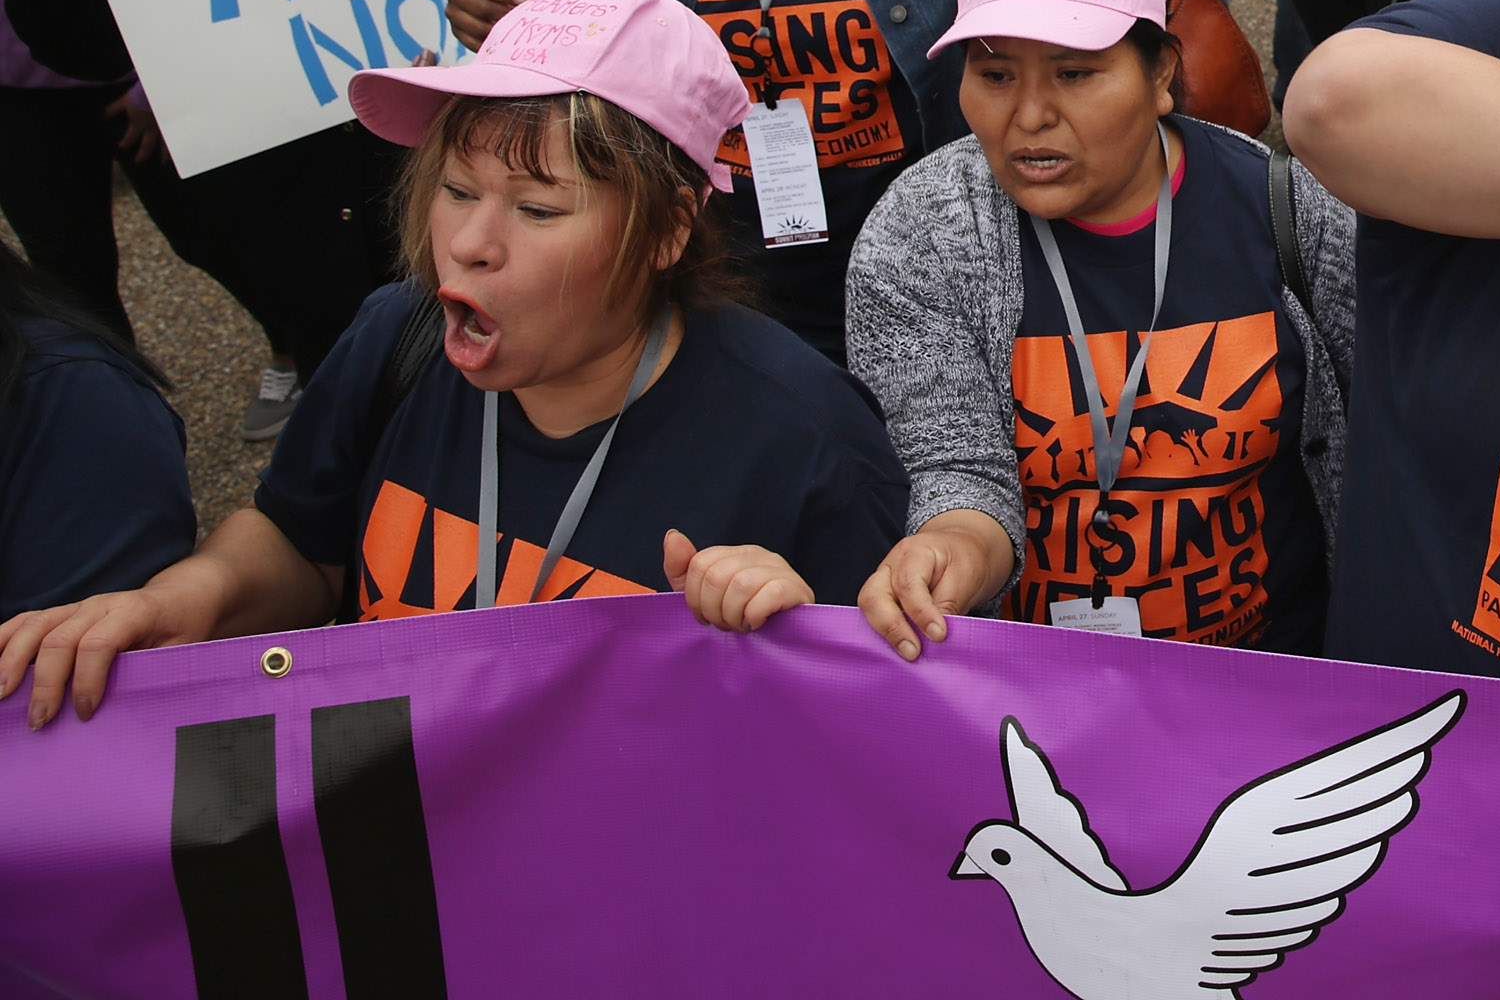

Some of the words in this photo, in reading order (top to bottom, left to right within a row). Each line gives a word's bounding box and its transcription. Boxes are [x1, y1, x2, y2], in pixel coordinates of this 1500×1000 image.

[510, 47, 548, 65] USA
[1026, 495, 1258, 577] RISING
[1451, 619, 1495, 654] NATIONAL
